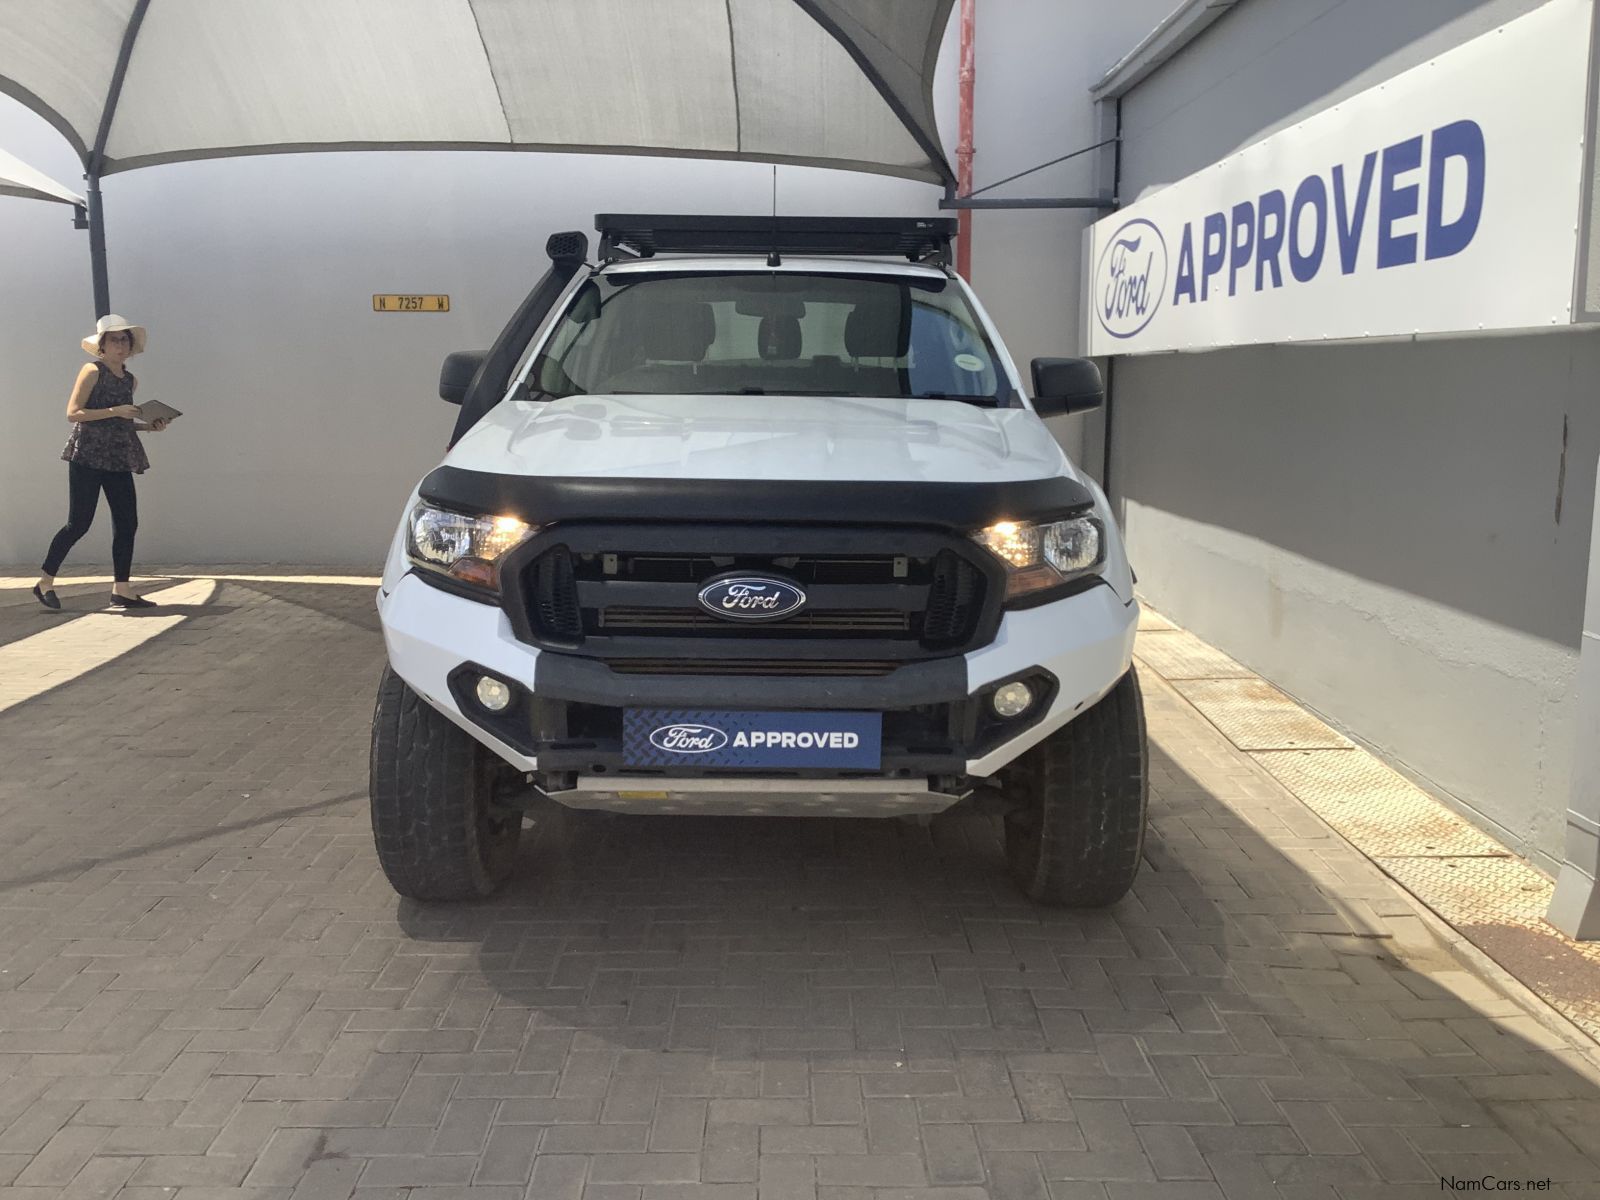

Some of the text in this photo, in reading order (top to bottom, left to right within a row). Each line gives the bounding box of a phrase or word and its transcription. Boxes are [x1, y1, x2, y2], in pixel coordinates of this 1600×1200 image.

[1104, 119, 1486, 320] Ford APPROVED
[379, 297, 444, 310] N 7257 W
[722, 584, 780, 609] Ford
[663, 727, 859, 749] Ford APPROVED
